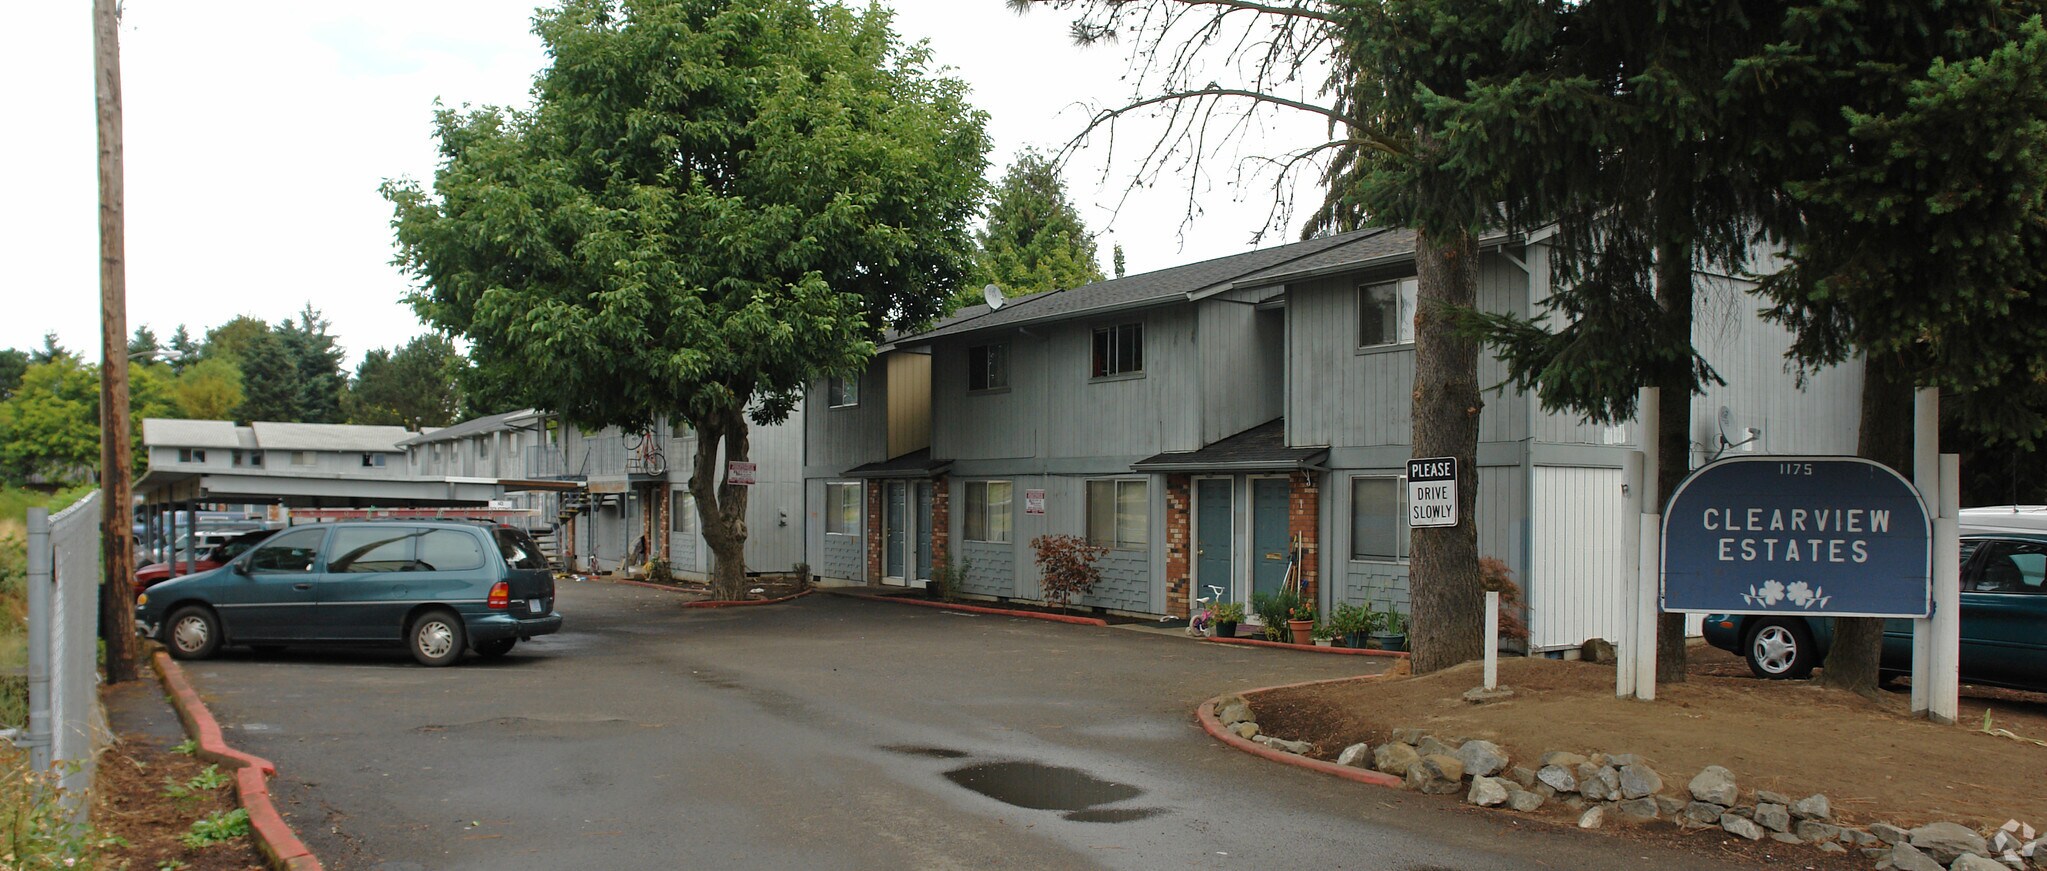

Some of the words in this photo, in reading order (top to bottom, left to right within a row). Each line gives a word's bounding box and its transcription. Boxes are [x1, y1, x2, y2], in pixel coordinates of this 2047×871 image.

[1412, 462, 1451, 478] PLEASE
[1780, 463, 1812, 475] 1175
[1417, 486, 1448, 501] DRIVE
[1413, 504, 1453, 519] SLOWLY
[1703, 508, 1890, 533] CLEARVIEW
[1718, 538, 1869, 563] ESTATES
